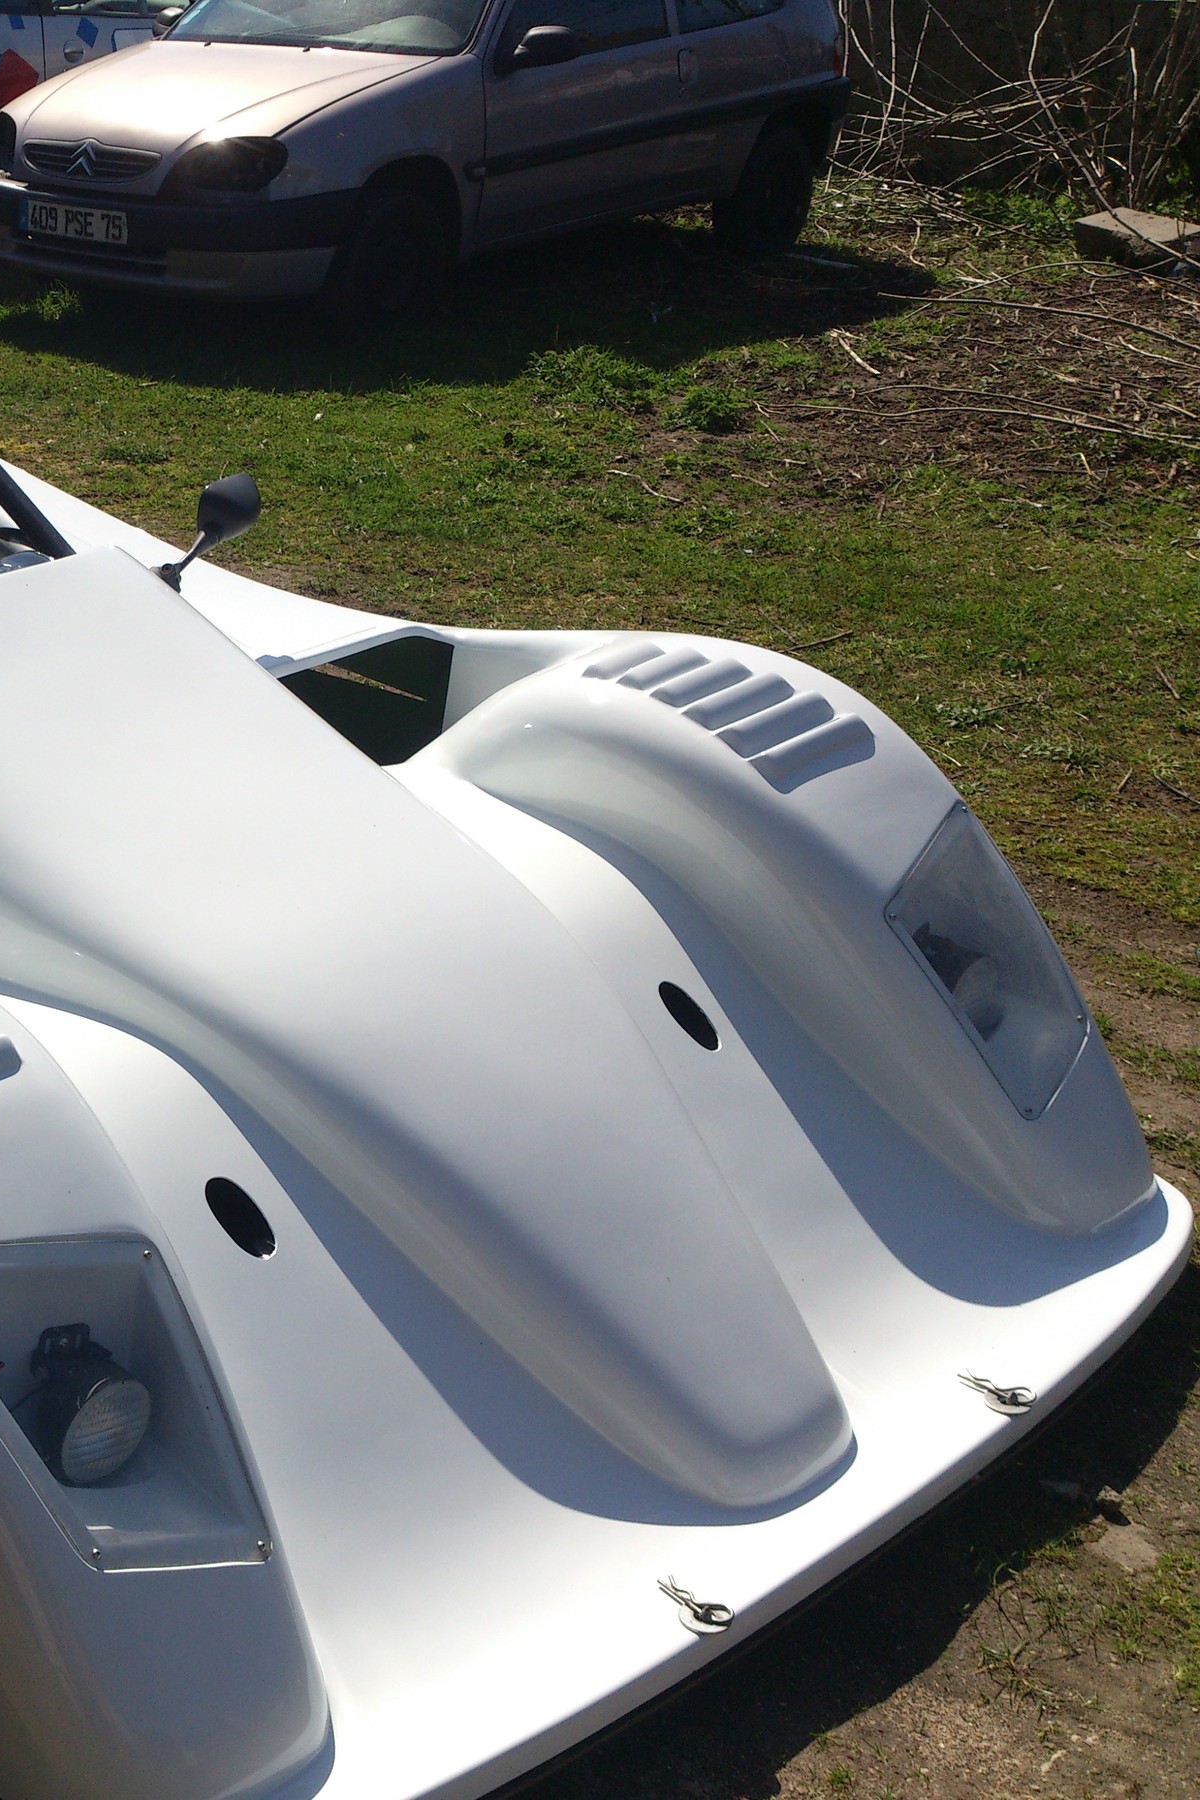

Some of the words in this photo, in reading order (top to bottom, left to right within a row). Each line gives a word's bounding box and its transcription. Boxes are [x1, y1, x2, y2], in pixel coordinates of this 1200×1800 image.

[30, 204, 58, 232] 409
[64, 208, 94, 237] PSE
[101, 213, 123, 239] 75
